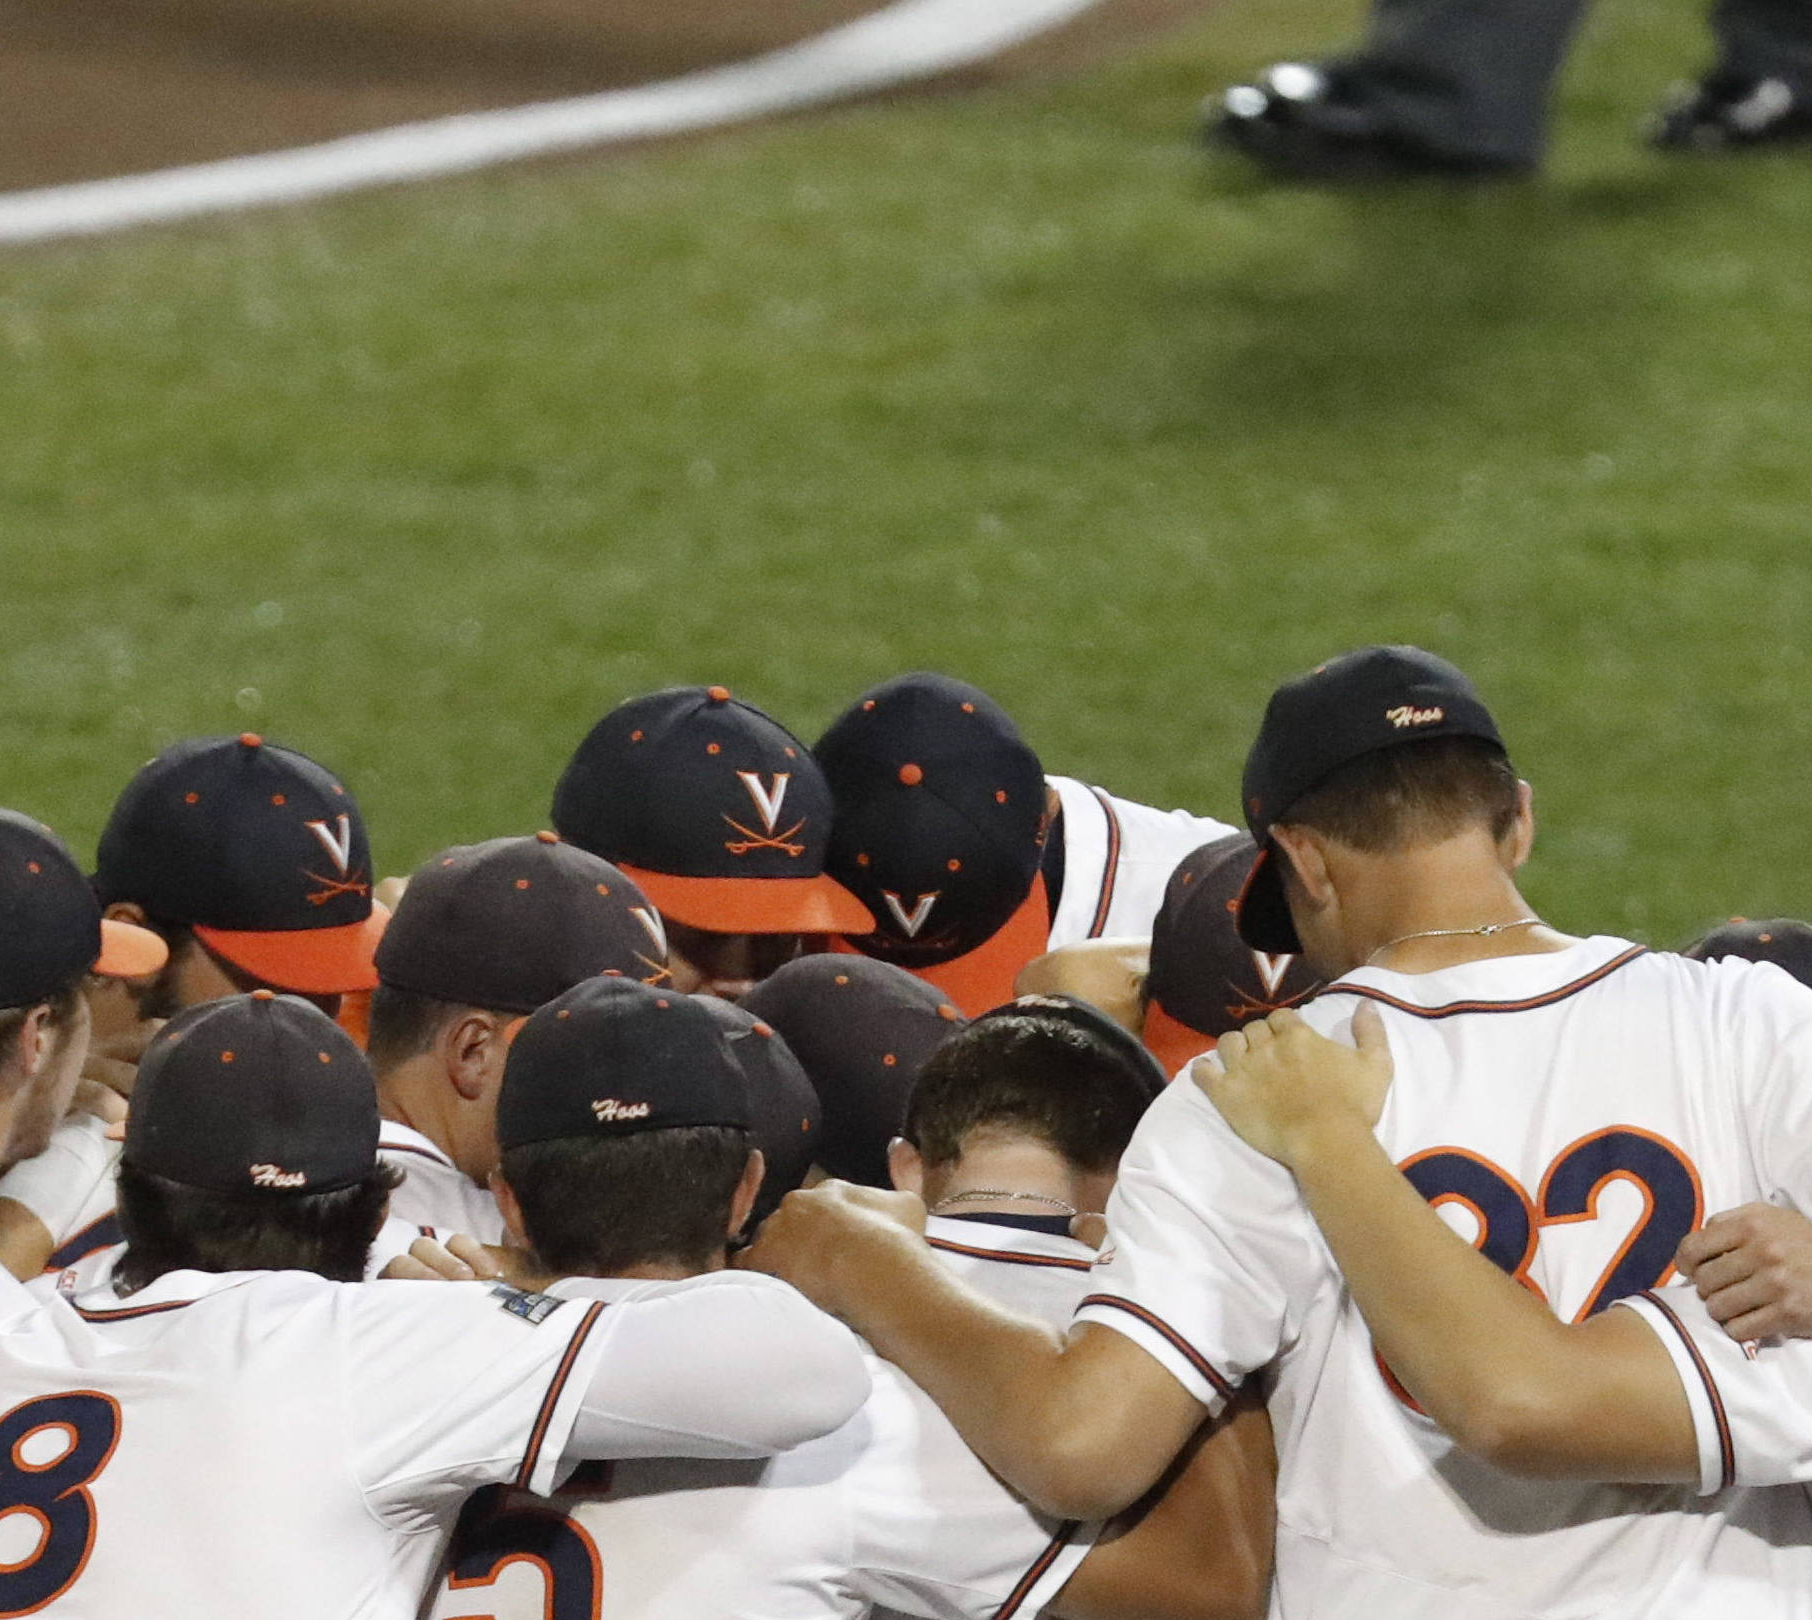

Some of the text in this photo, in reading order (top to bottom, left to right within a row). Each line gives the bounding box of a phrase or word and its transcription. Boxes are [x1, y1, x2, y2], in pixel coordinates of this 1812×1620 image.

[736, 770, 791, 836] V
[302, 812, 351, 880] V
[881, 888, 941, 939] V
